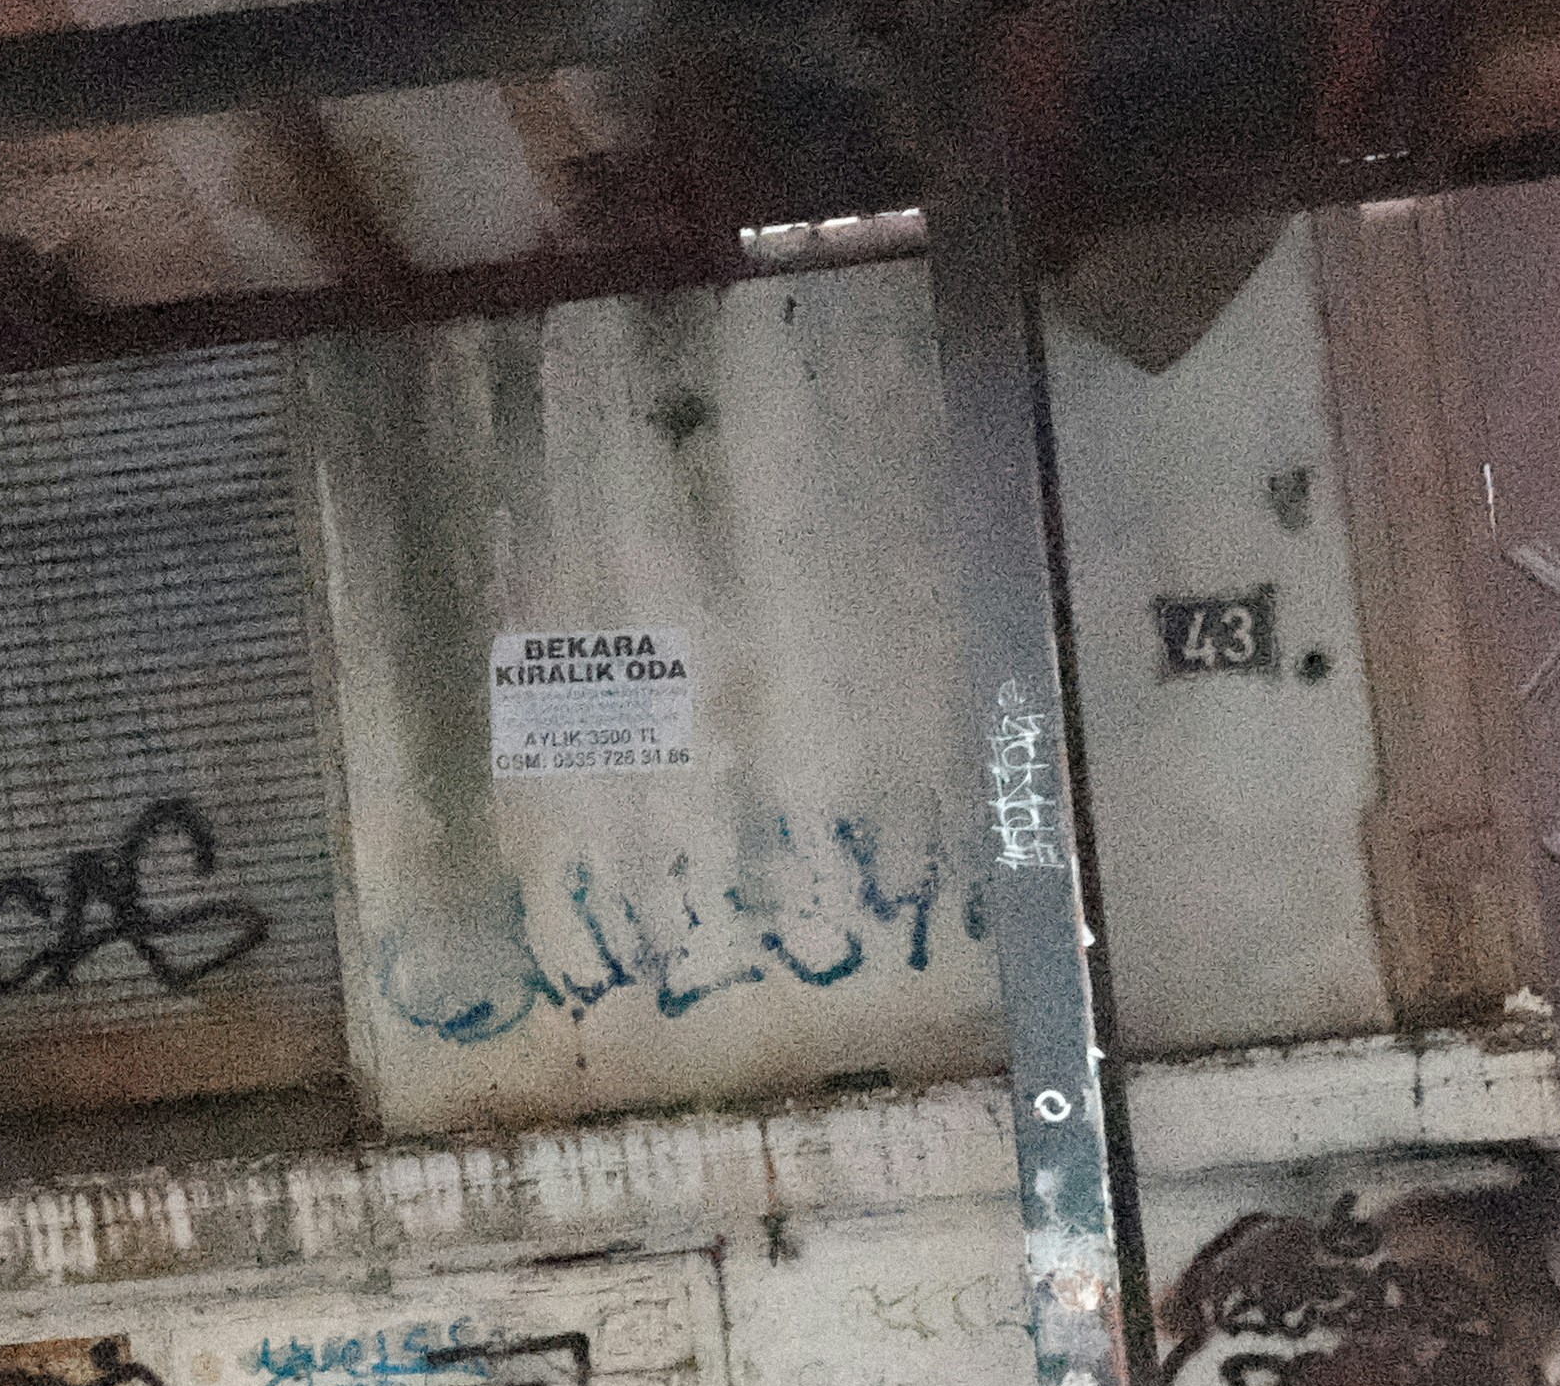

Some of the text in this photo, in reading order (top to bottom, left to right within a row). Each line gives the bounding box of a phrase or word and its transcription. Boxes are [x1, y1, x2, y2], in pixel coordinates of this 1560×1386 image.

[524, 634, 656, 660] BEKARA
[1182, 605, 1256, 667] 43
[625, 659, 688, 682] ODA
[524, 730, 582, 748] AYLIK
